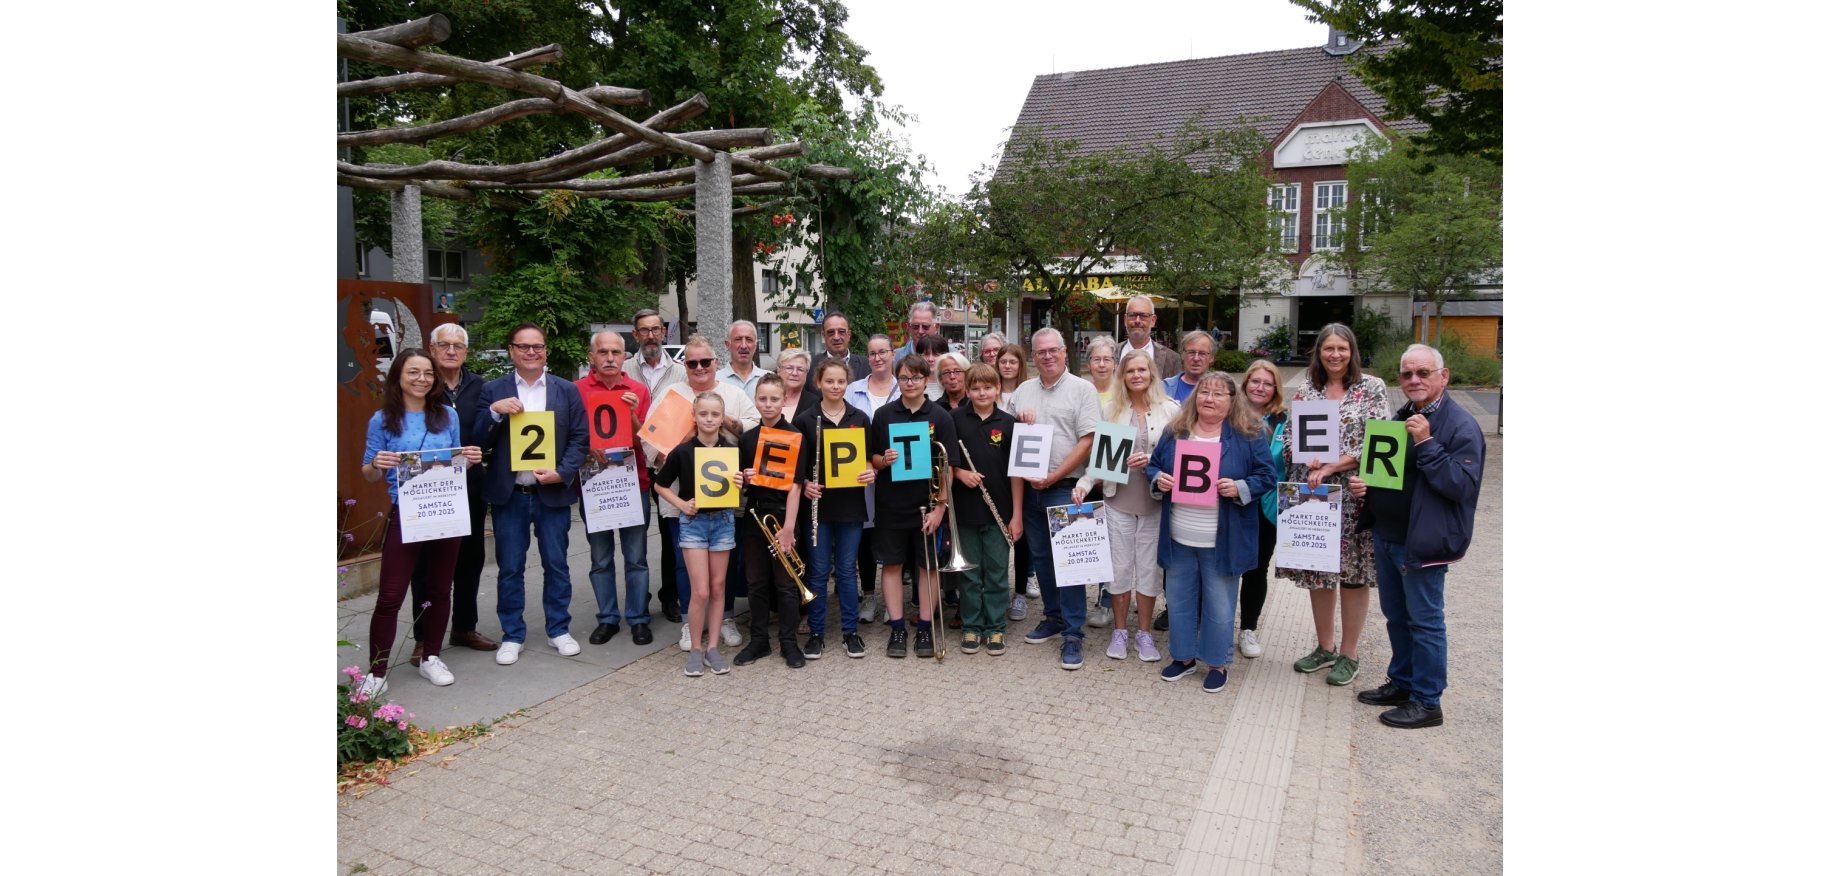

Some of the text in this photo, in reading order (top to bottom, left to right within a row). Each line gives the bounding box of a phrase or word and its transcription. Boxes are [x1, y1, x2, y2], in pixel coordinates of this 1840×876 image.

[593, 404, 618, 439] 0
[1298, 414, 1330, 453] E
[520, 424, 546, 461] 2
[892, 435, 921, 471] T
[1014, 435, 1043, 468] E
[1095, 434, 1134, 475] M
[1365, 434, 1399, 478] R
[760, 441, 790, 479] E
[829, 441, 858, 478] P
[699, 460, 731, 498] S
[1178, 453, 1212, 494] B
[586, 482, 635, 493] MÖGLICHKEITEN
[592, 479, 613, 487] MARKT
[403, 485, 462, 496] MÖGLICHKEITEN
[418, 500, 452, 509] SAMSTAG
[599, 495, 627, 504] SAMSTAG
[598, 501, 630, 510] 20.09.2025
[417, 508, 455, 517] 20.09.2025
[1281, 519, 1336, 527] MÖGLICHKEITEN
[1055, 536, 1105, 545] MÖGLICHKEITEN
[1293, 533, 1325, 541] SAMSTAG
[1292, 540, 1326, 548] 20.09.2025
[1068, 549, 1097, 557] SAMSTAG
[1067, 556, 1099, 564] 20.09.2025
